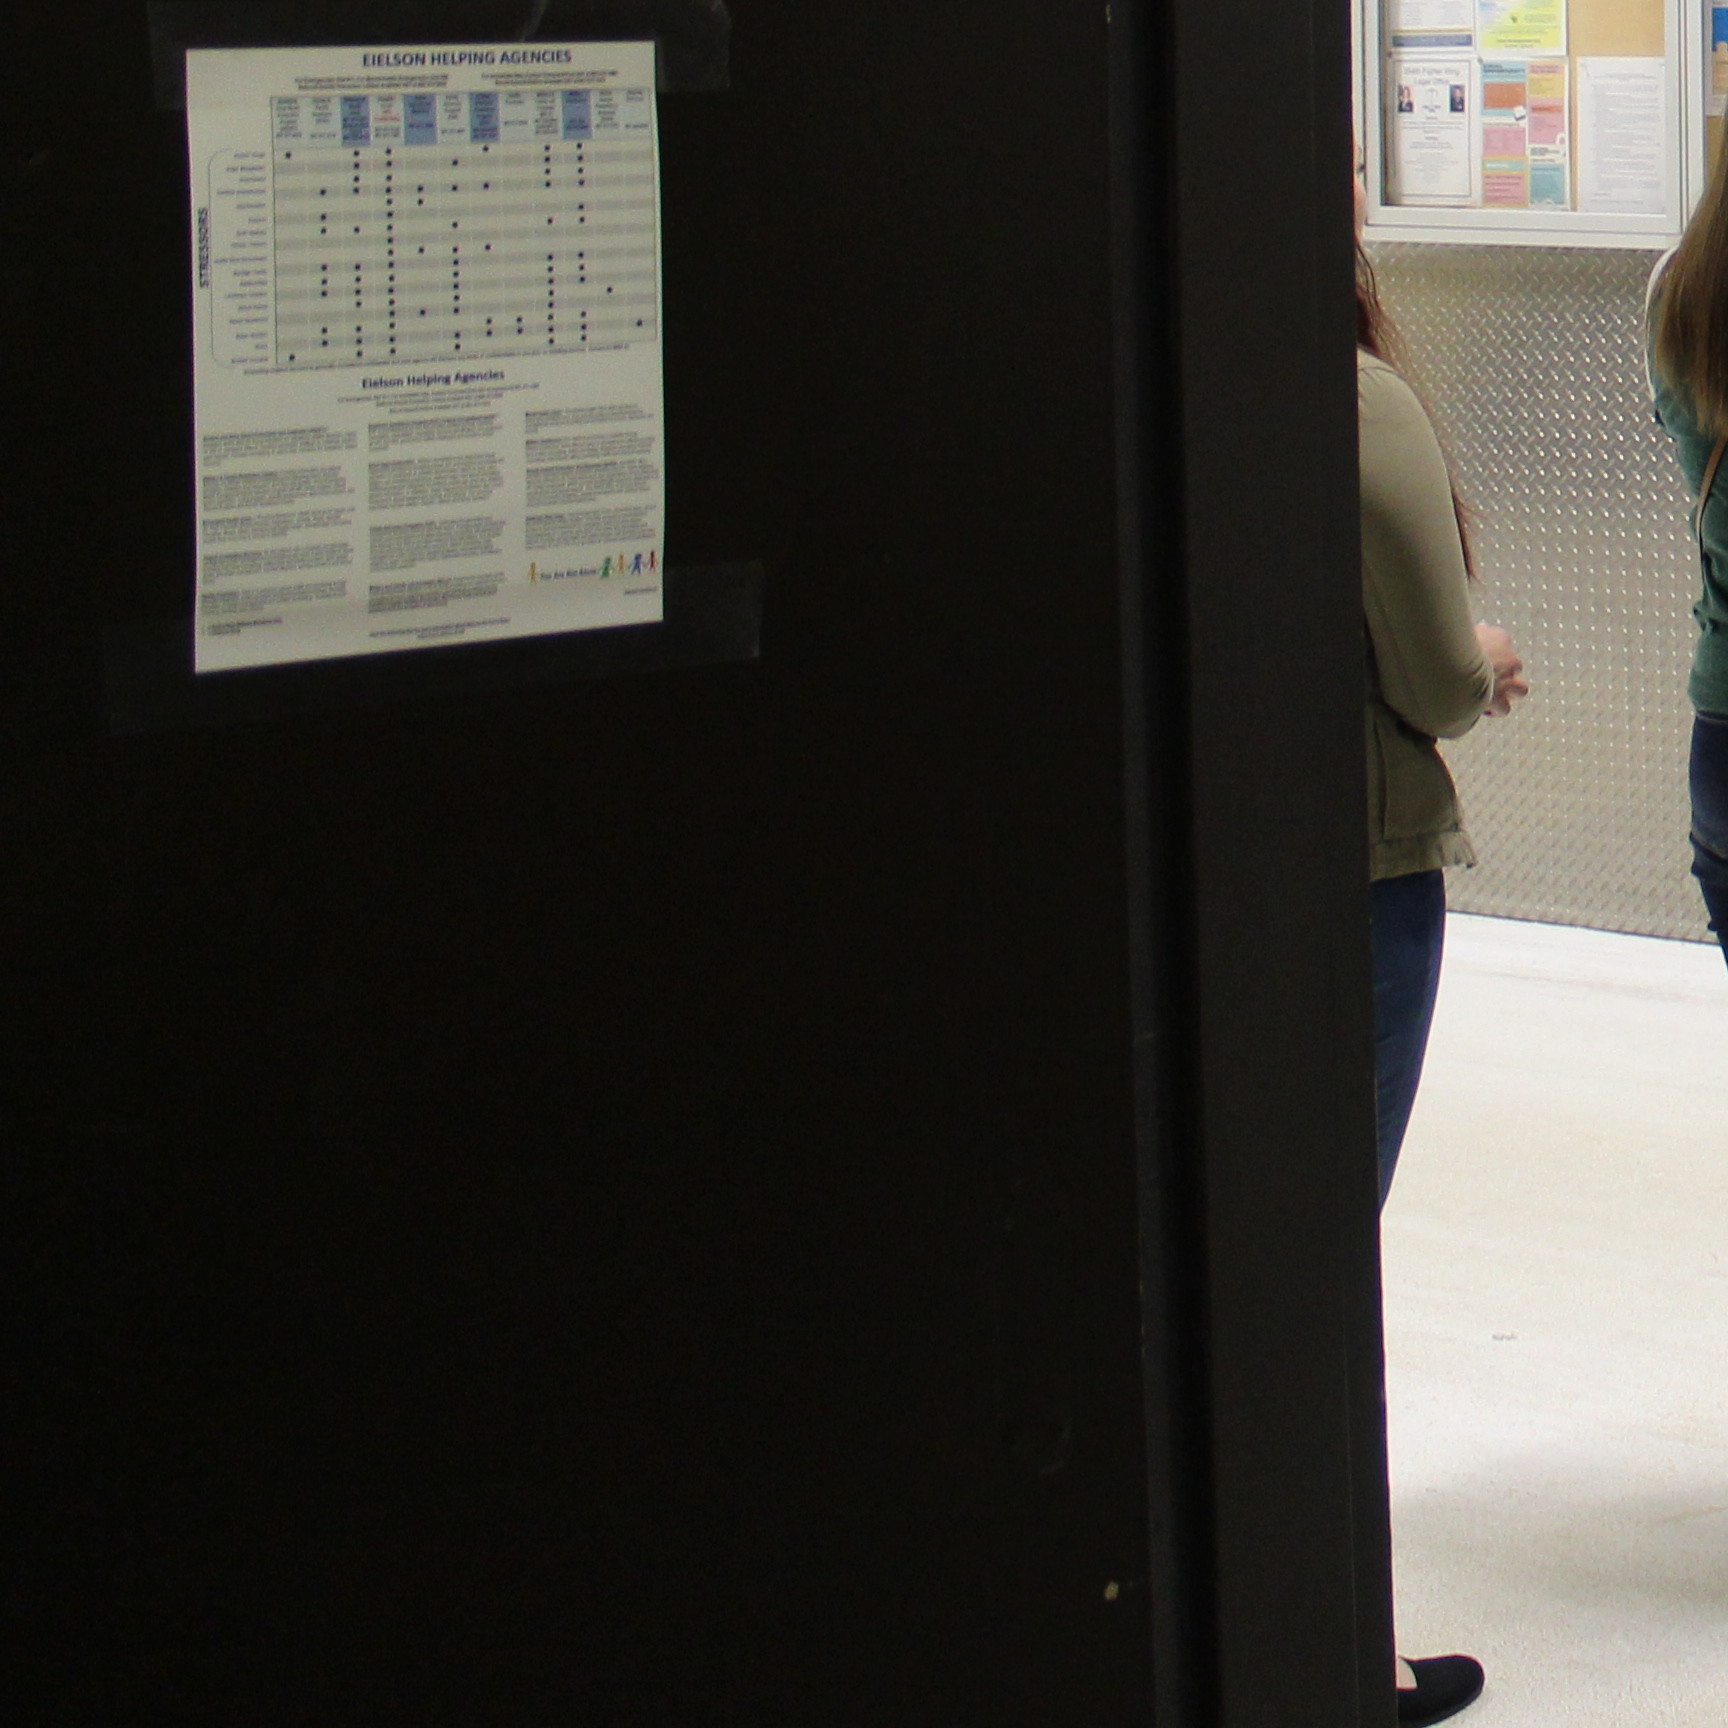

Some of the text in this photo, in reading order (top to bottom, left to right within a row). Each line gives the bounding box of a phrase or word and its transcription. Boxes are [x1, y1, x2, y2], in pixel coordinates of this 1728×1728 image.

[363, 49, 572, 67] EIELSON HELPING AGENCIES
[198, 208, 209, 288] STRESSORS
[361, 369, 505, 390] Eielson Helping Agencies
